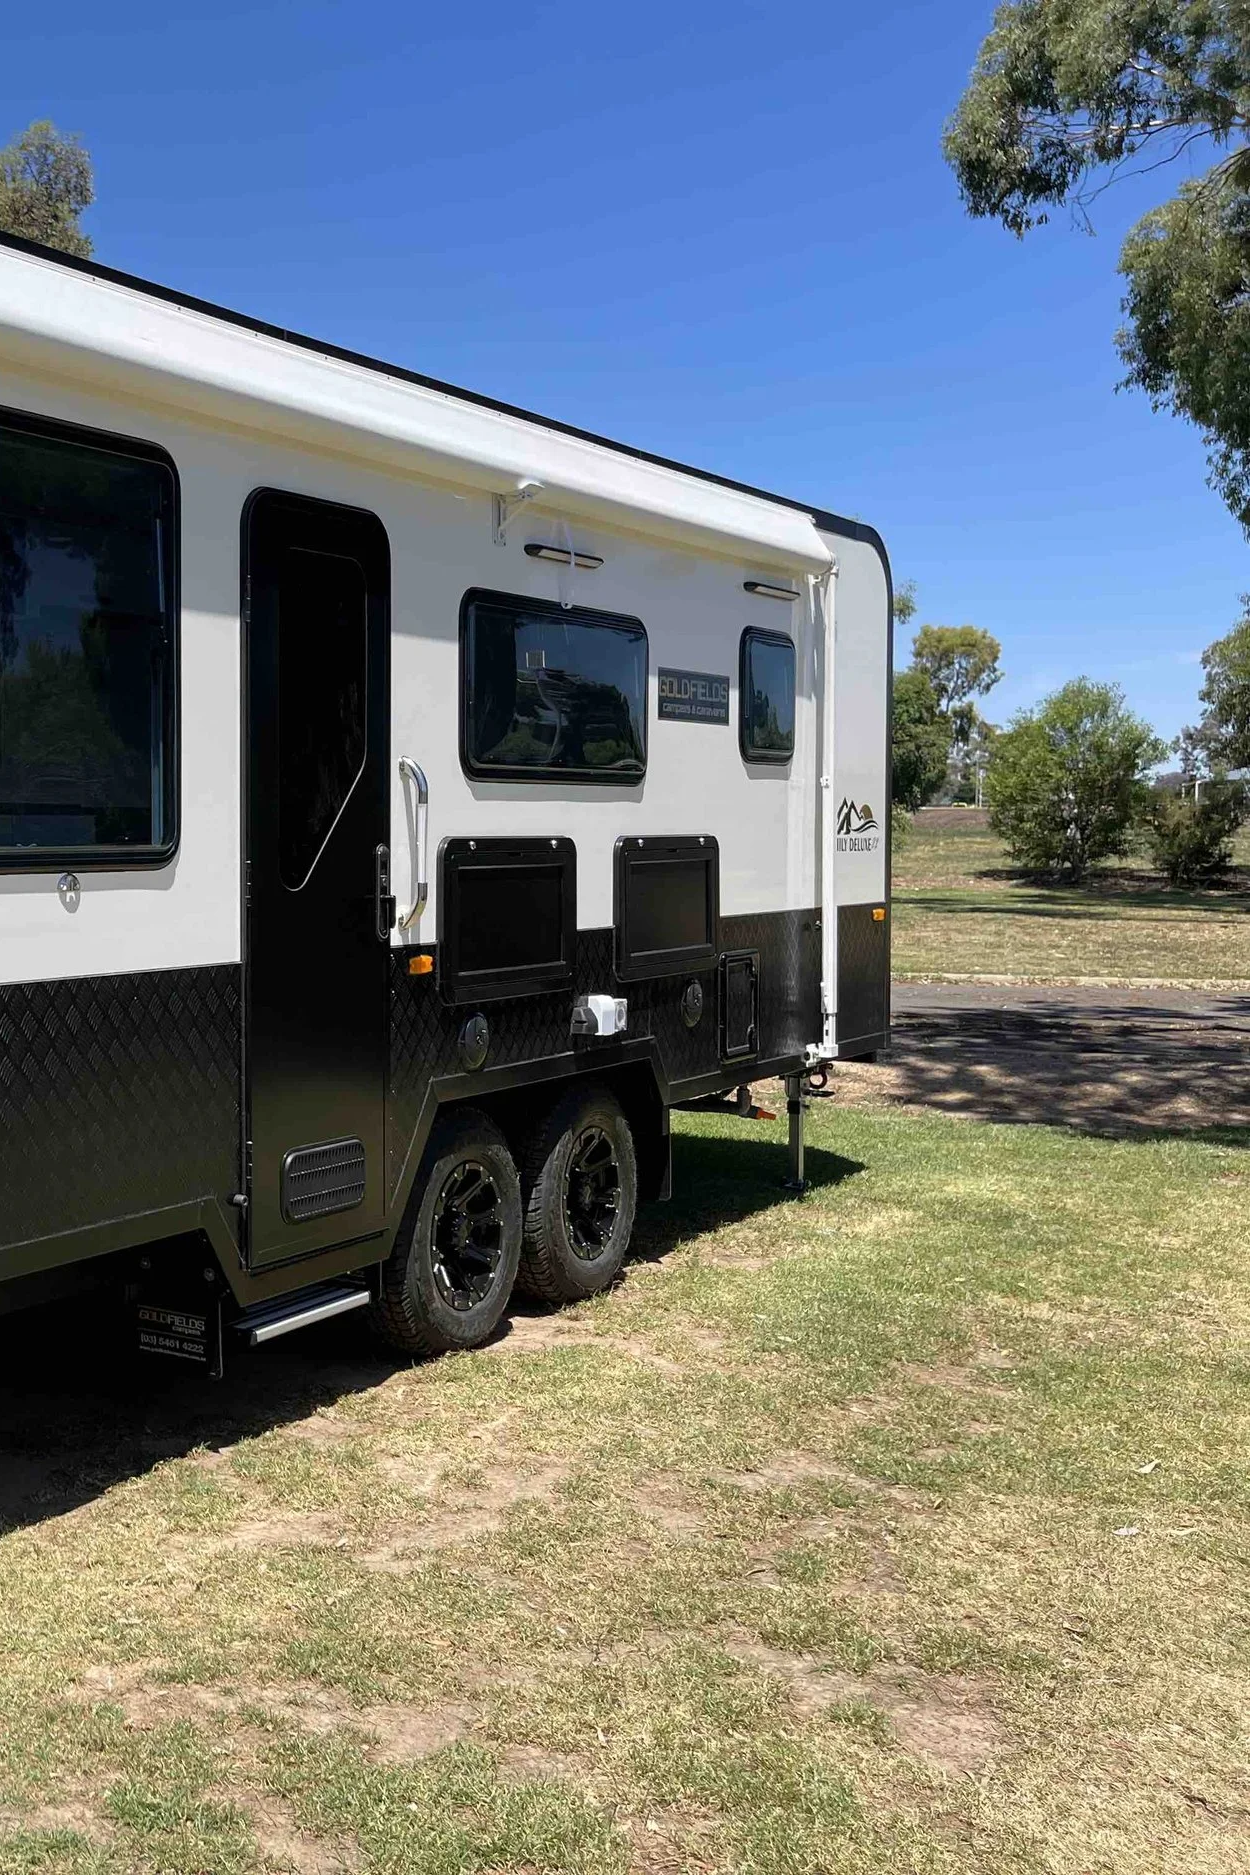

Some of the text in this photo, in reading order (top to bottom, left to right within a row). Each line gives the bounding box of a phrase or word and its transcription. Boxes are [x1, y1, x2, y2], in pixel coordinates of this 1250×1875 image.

[659, 676, 728, 703] GOLDFIELDS
[662, 703, 690, 715] campers
[696, 706, 726, 718] caravans
[849, 837, 871, 852] DELUXE
[138, 1309, 206, 1331] GOLDFIELDS
[141, 1332, 157, 1345] (03)
[182, 1341, 205, 1354] 4222
